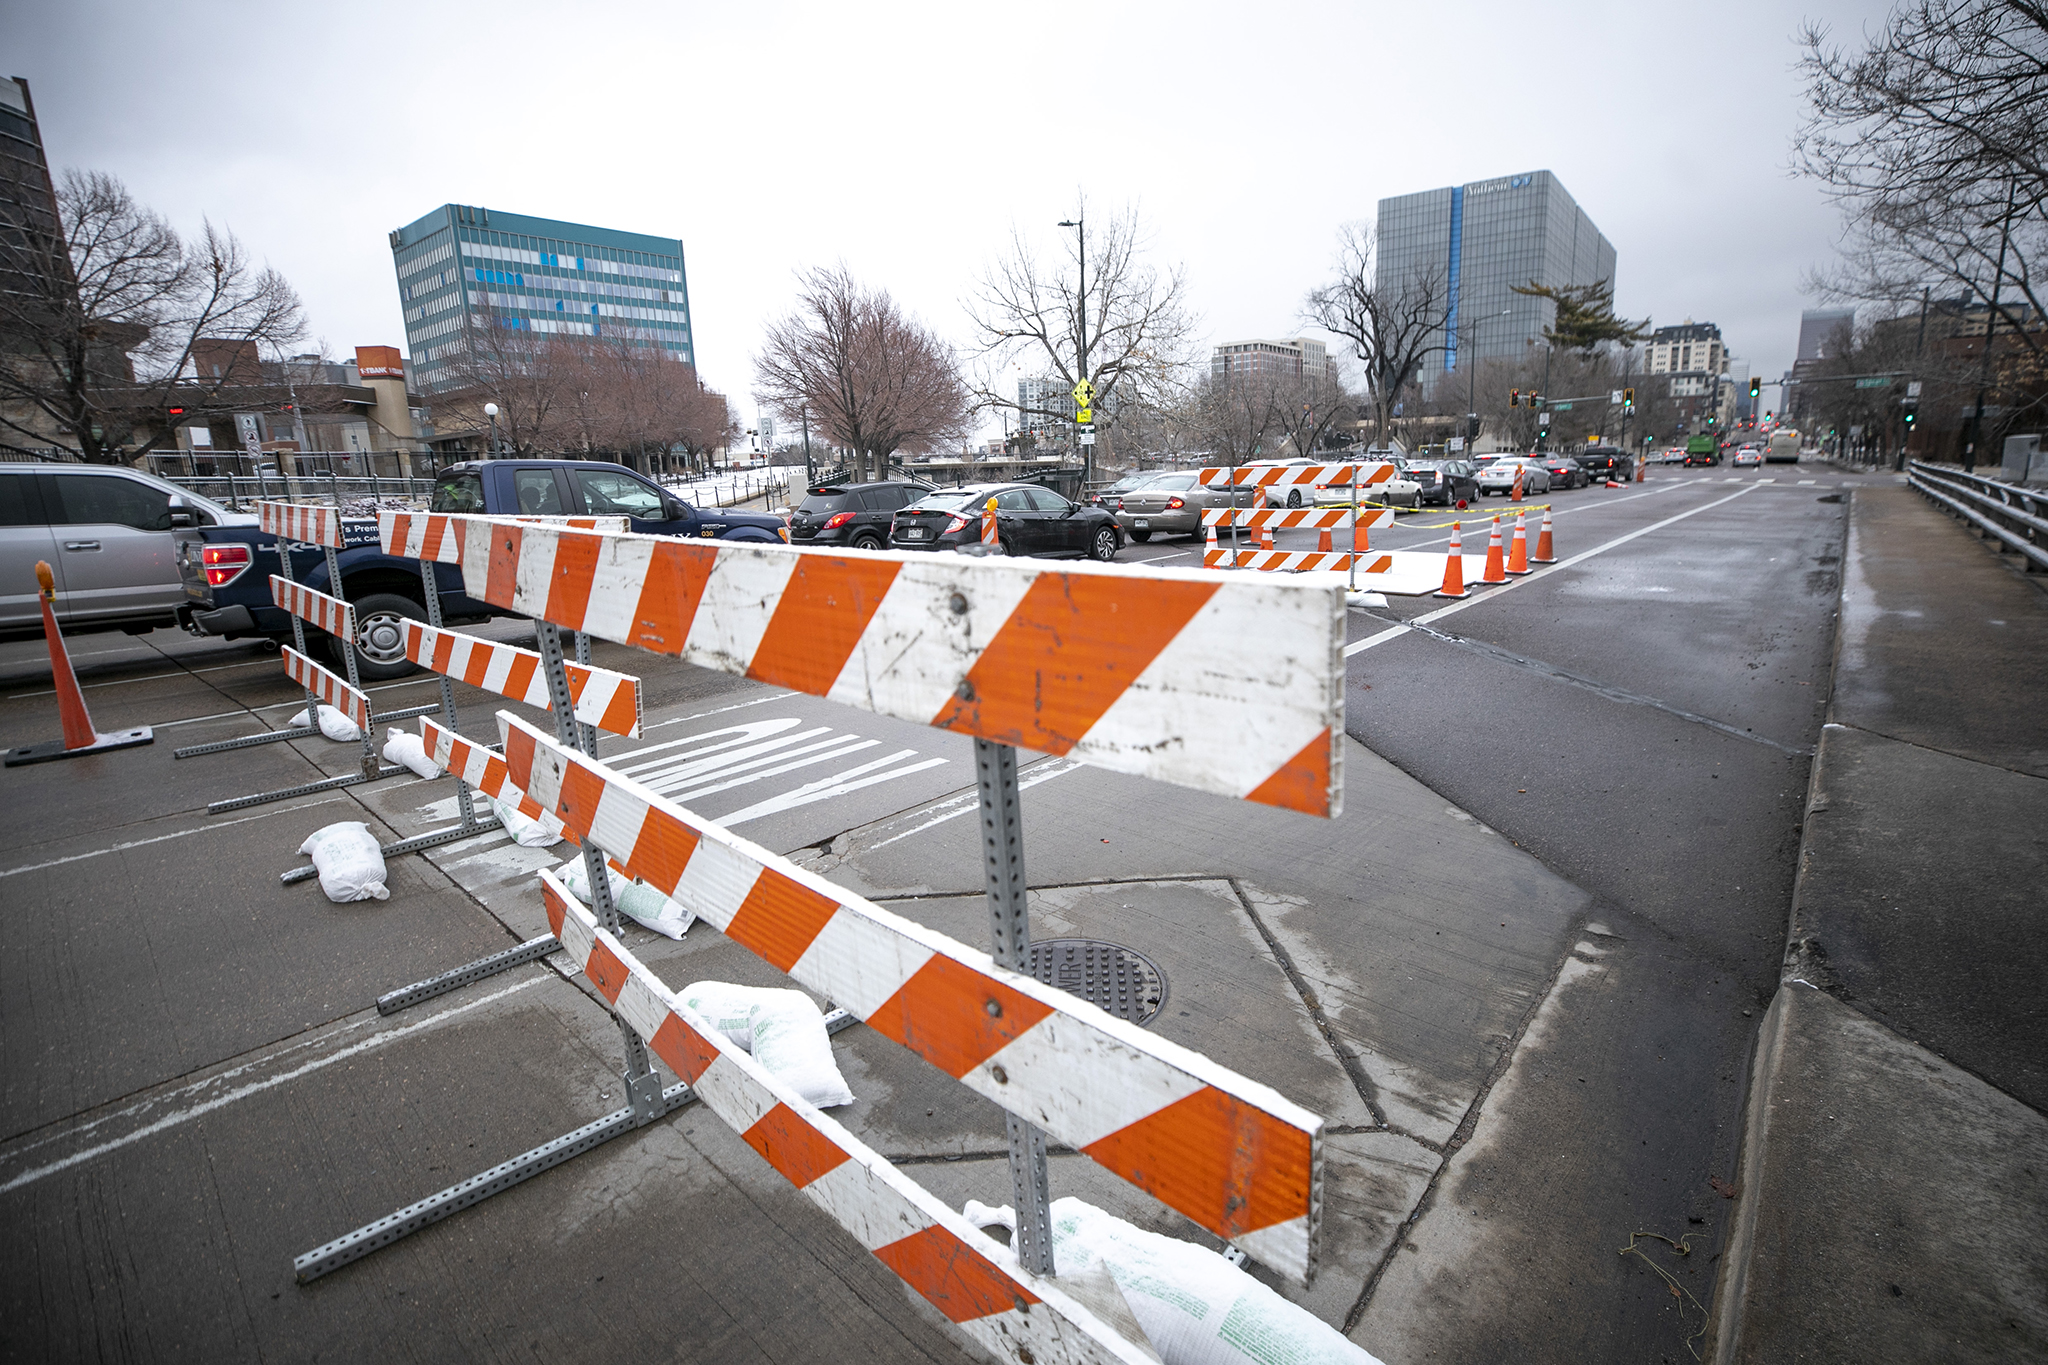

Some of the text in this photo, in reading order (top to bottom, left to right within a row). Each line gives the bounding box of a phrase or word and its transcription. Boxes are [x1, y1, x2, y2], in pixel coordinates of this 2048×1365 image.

[1468, 182, 1507, 196] Anthem
[354, 525, 379, 533] Prem
[701, 530, 714, 538] 030
